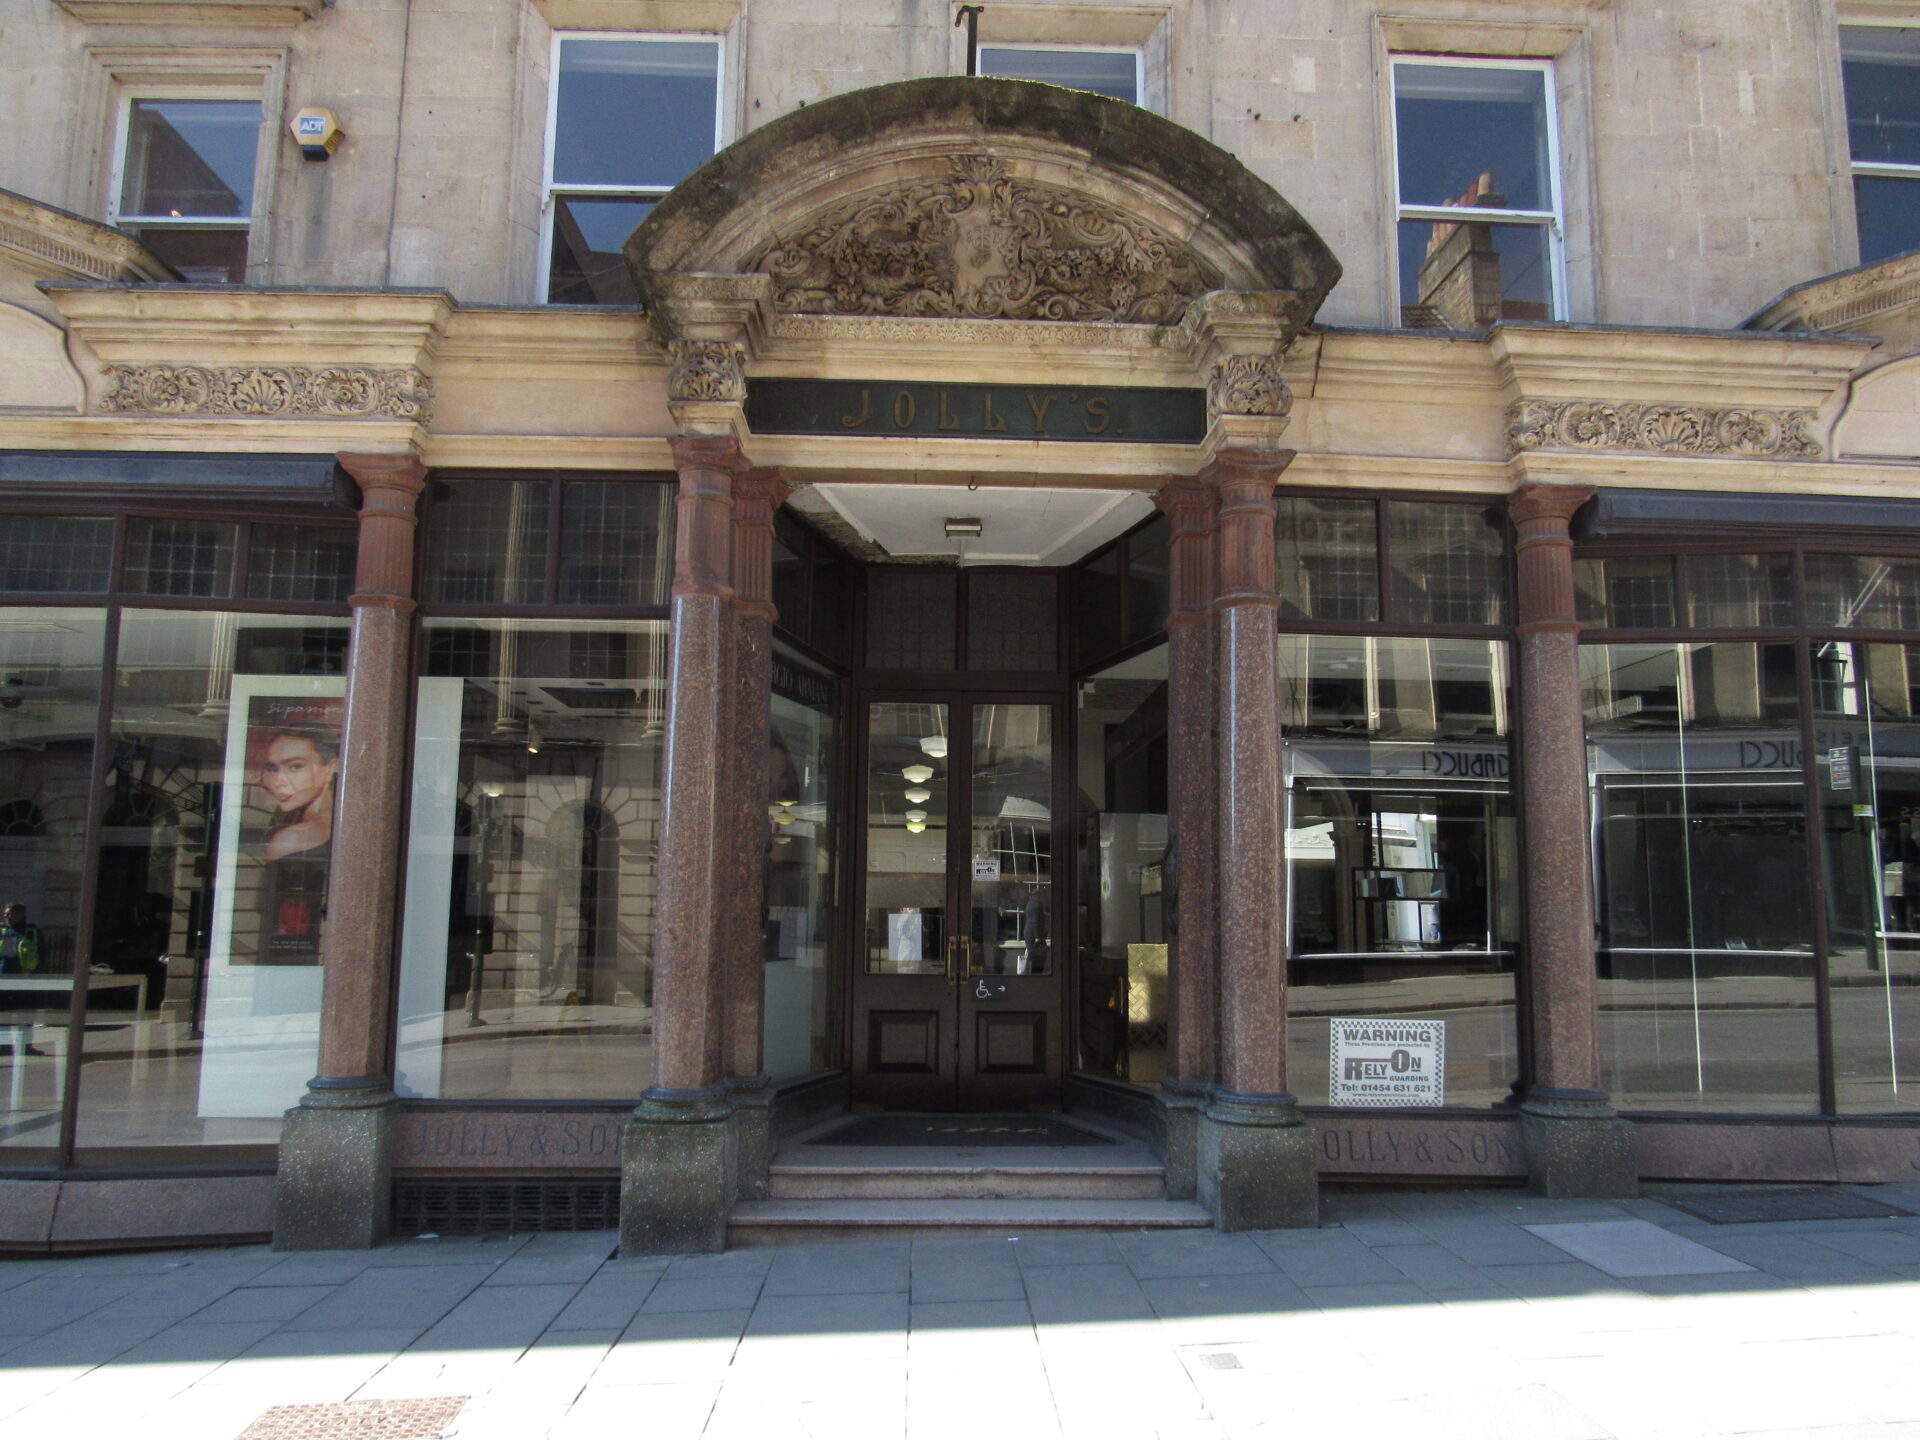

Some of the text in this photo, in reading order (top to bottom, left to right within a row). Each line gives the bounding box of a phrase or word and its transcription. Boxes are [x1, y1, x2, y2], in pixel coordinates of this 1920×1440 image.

[300, 120, 325, 131] ADT
[1343, 1029, 1432, 1042] WARNING
[1361, 1084, 1391, 1092] 01454
[409, 1119, 520, 1157] JOLLY
[529, 1124, 547, 1156] &
[1323, 1129, 1403, 1163] OLLY
[1415, 1132, 1434, 1164] &
